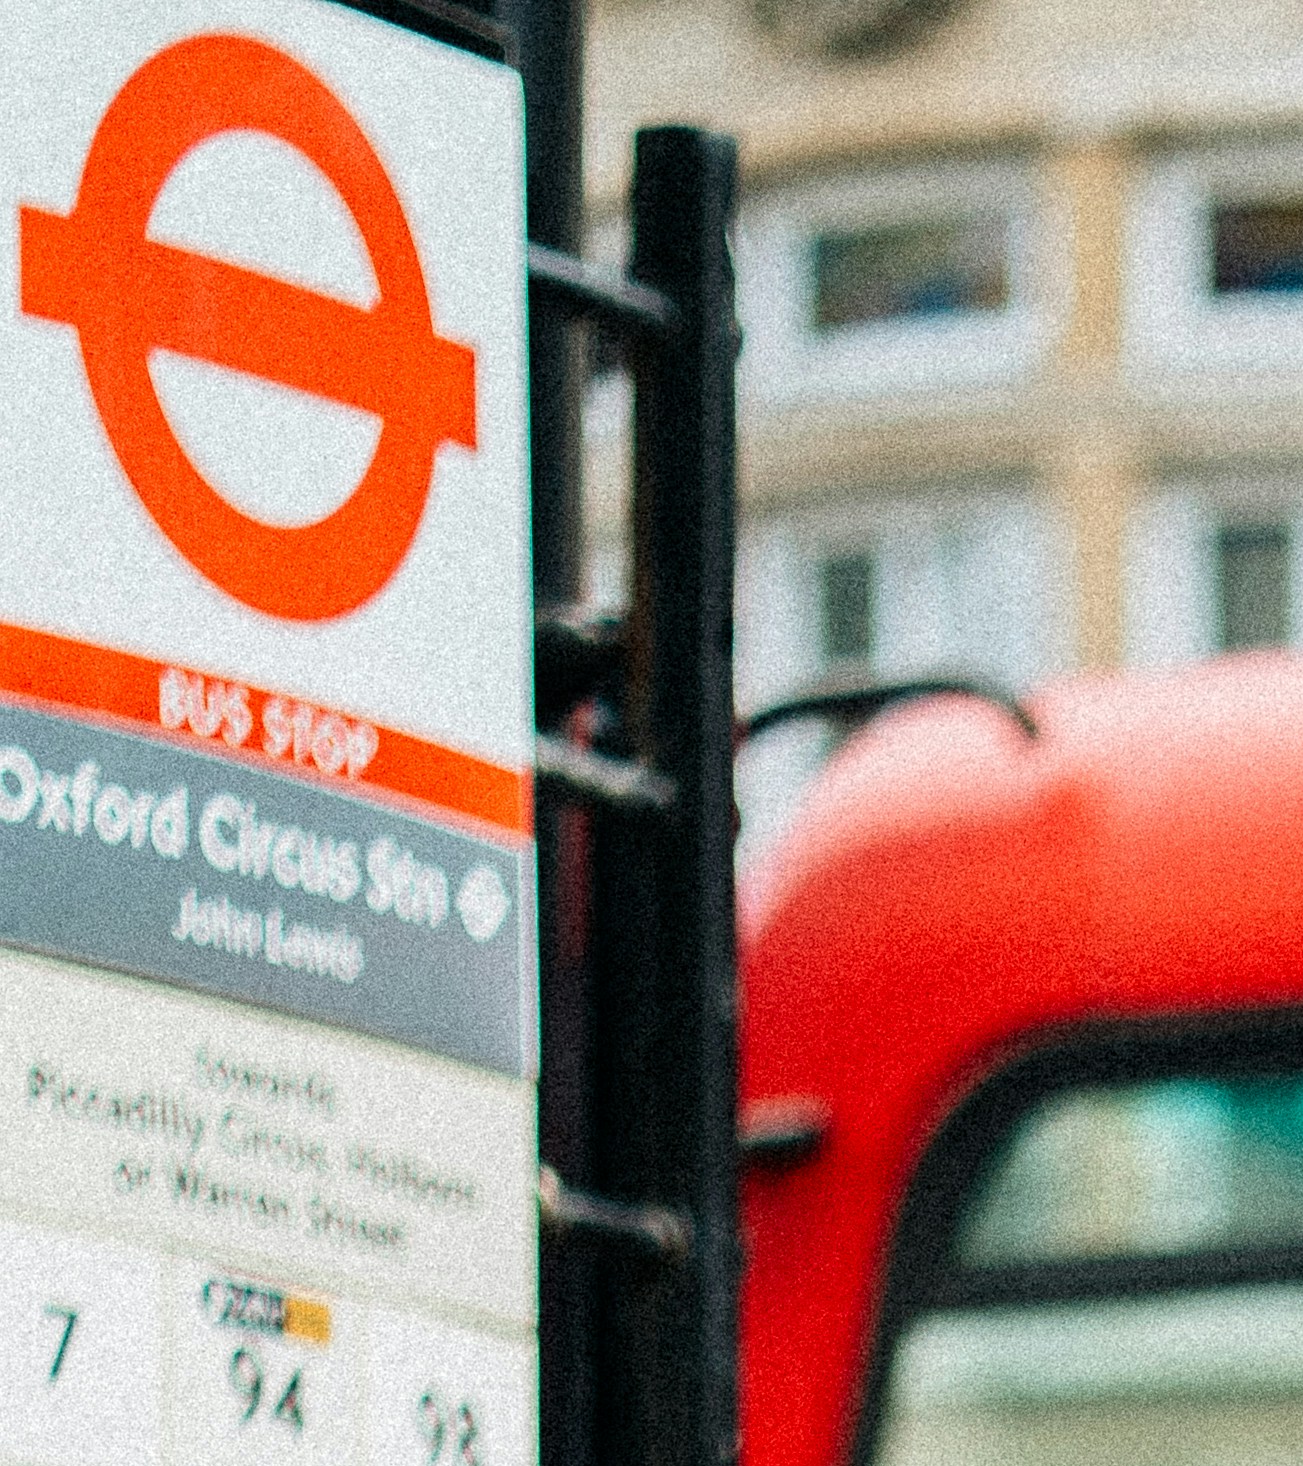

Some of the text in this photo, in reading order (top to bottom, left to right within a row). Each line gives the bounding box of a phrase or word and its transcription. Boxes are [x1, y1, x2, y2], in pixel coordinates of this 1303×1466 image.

[157, 666, 380, 780] BUS STOP
[0, 744, 450, 930] Oxford Circus Stn
[171, 887, 365, 986] John Lewis
[27, 1062, 205, 1154] Piccadilly
[44, 1302, 79, 1386] 7
[229, 1345, 305, 1435] 94
